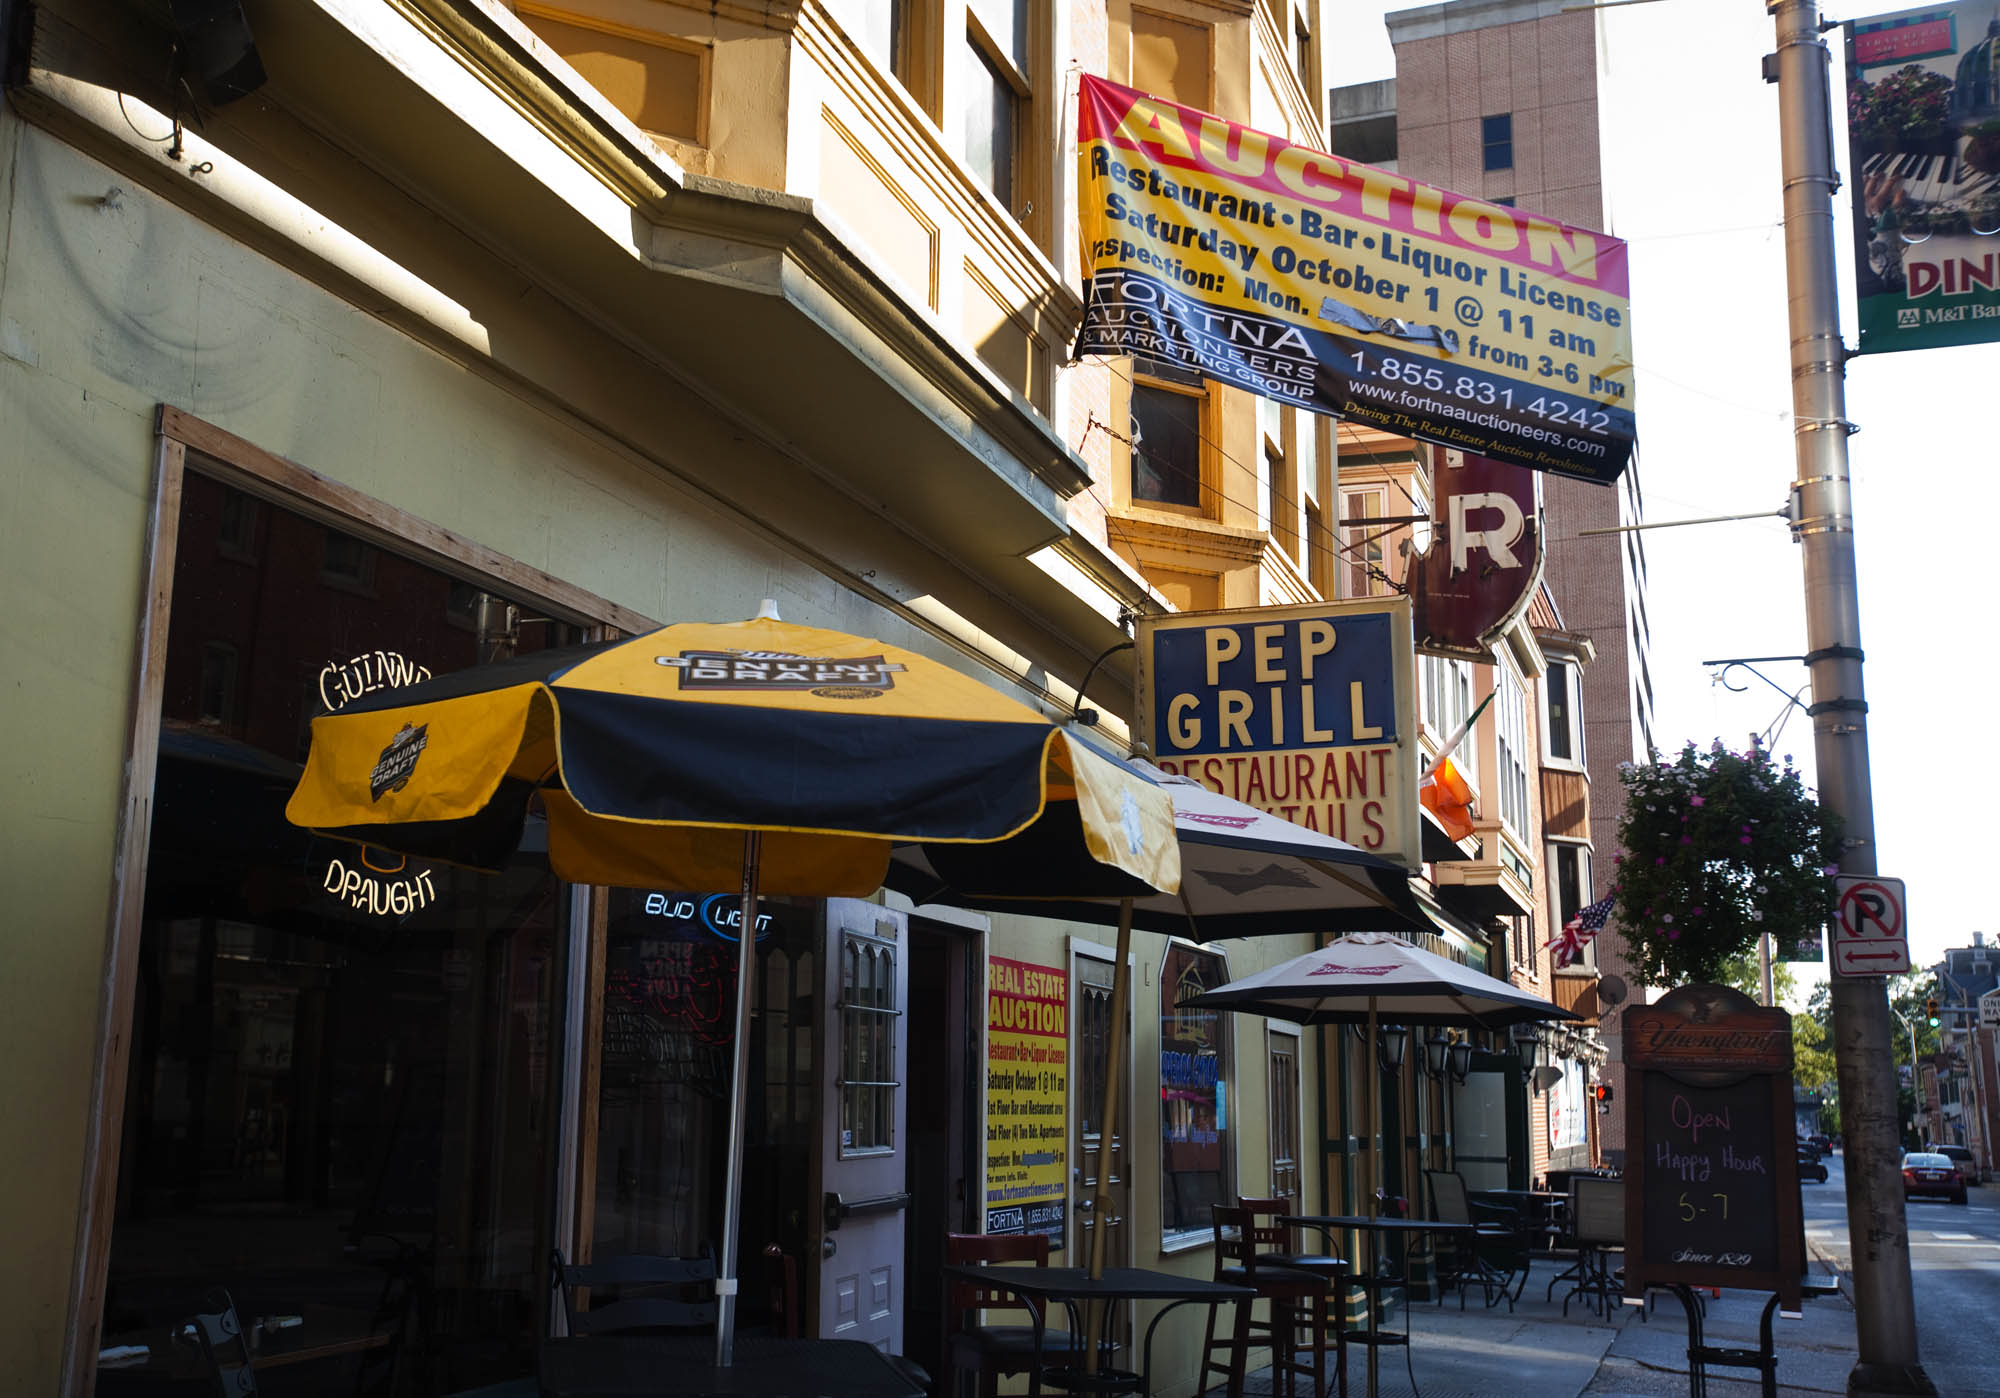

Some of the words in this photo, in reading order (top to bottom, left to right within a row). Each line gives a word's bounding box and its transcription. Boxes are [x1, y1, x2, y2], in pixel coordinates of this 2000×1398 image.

[1113, 96, 1597, 280] AUCTION
[1105, 193, 1259, 272] Saturday
[1272, 246, 1410, 303] October
[1424, 287, 1439, 312] 1
[1455, 296, 1483, 327] @
[1498, 309, 1533, 339] 11
[1549, 329, 1596, 357] am
[1500, 267, 1621, 327] License
[1907, 252, 2000, 299] DIN
[1244, 277, 1308, 315] Mon.
[1469, 336, 1528, 370] from
[1538, 355, 1579, 384] 3-6
[1589, 374, 1625, 399] pm
[1925, 307, 1968, 324] M&T
[1088, 309, 1315, 380] AUCTIONEERS
[1100, 329, 1231, 373] MARKETING
[1236, 367, 1314, 398] GROUP
[1350, 381, 1606, 457] www.fortnaauctioneers.com
[1351, 351, 1610, 435] 1.855.831.4242
[1343, 401, 1391, 424] Driving
[1394, 413, 1417, 428] The
[1419, 420, 1447, 438] Real
[1449, 428, 1485, 447] Estate
[1488, 439, 1534, 460] Auction
[1448, 492, 1524, 584] R
[655, 657, 907, 673] GENUINE
[692, 668, 876, 682] DRAFT
[1205, 620, 1337, 686] PEP
[1168, 681, 1383, 750] GRILL
[370, 736, 427, 778] GENUINE
[372, 754, 417, 788] DRAFT
[324, 859, 436, 916] DRAUGHT
[645, 893, 695, 920] BUD
[989, 963, 1020, 994] REAL
[1024, 970, 1064, 1001] ESTATE
[989, 996, 1064, 1034] AUCTION
[1016, 1069, 1036, 1090] October
[1038, 1072, 1042, 1090] 1
[1050, 1072, 1056, 1091] 11
[988, 1208, 1024, 1230] FORTNA
[1679, 1192, 1728, 1223] 5-7
